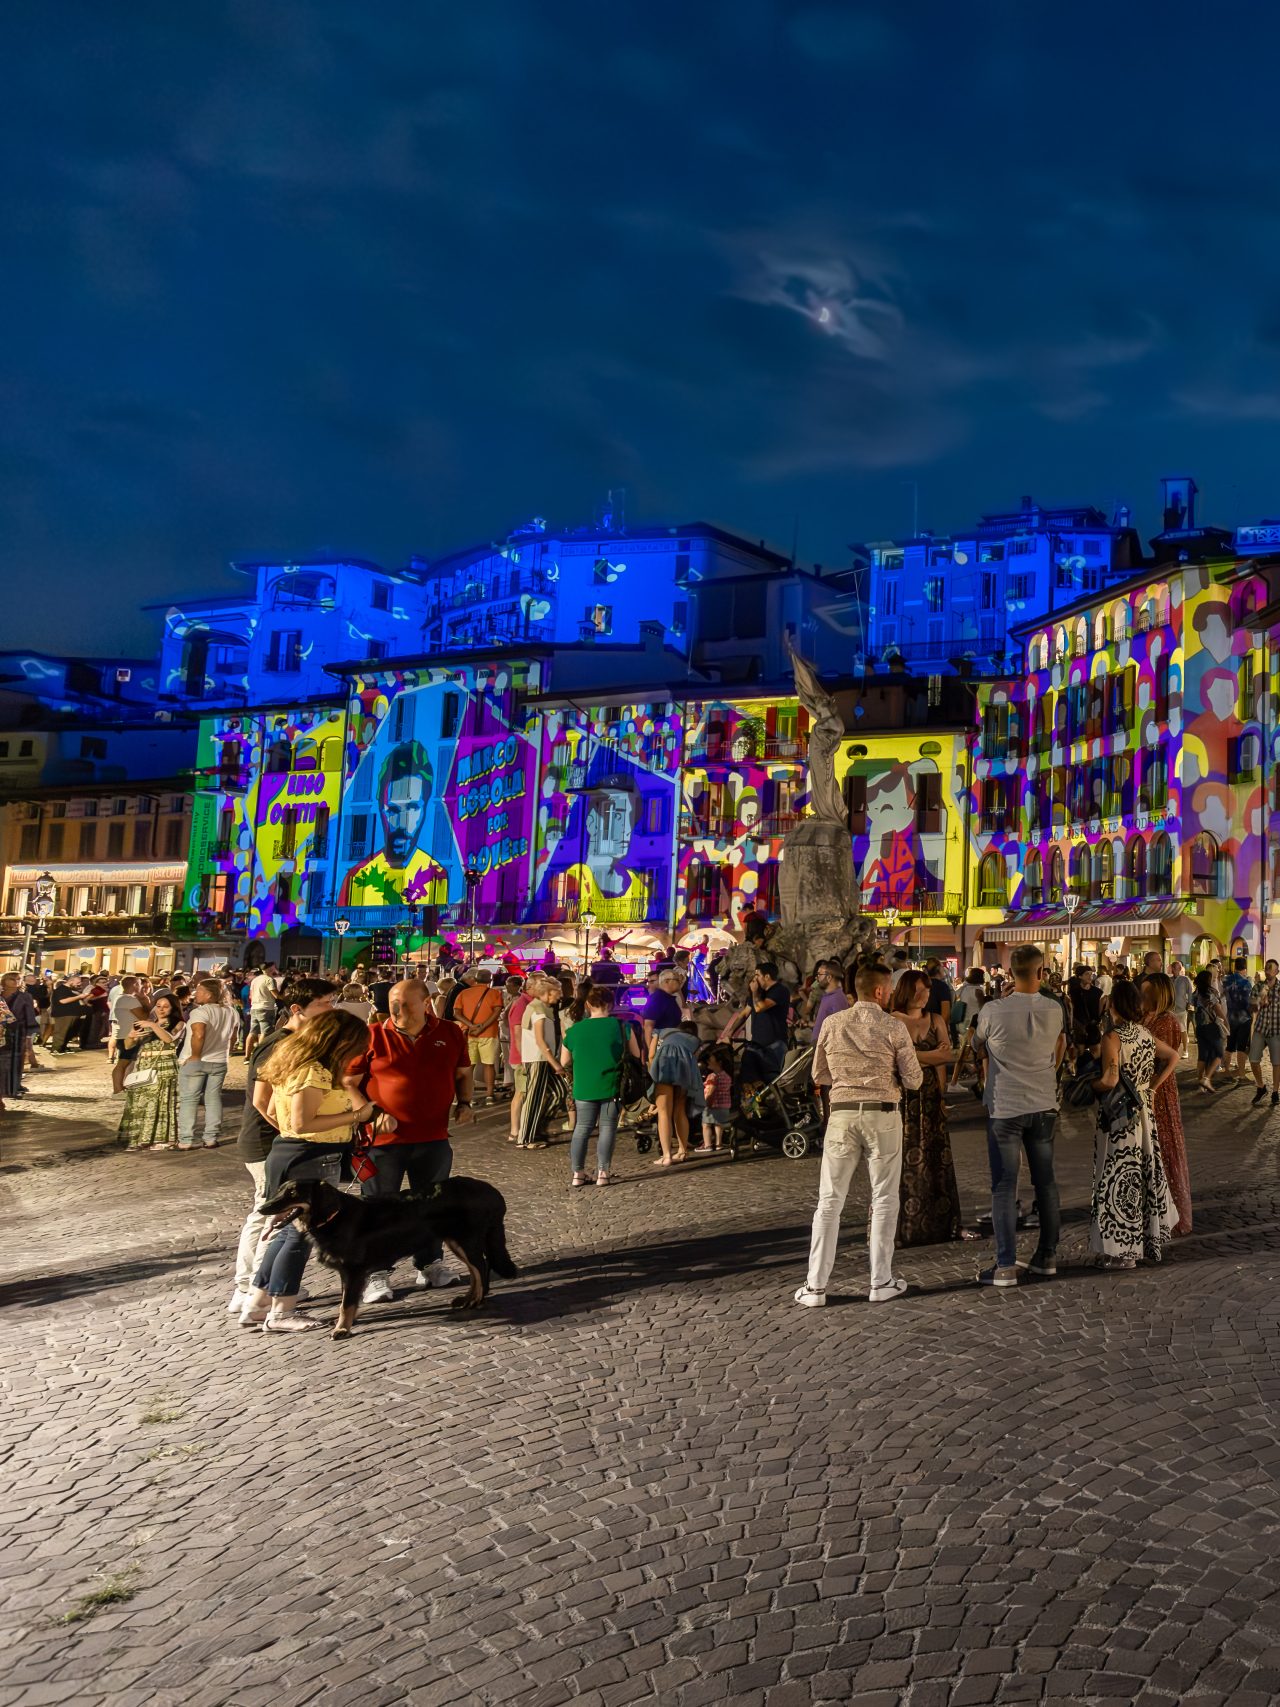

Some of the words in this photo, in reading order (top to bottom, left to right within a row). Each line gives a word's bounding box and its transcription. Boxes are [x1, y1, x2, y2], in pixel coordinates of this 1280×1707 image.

[456, 735, 518, 786] MARCO
[457, 768, 525, 822] LODOLA
[487, 812, 509, 835] FOR
[1065, 821, 1119, 840] RISTORANTE
[1126, 812, 1175, 830] MODERNO
[467, 836, 528, 876] LOVERE
